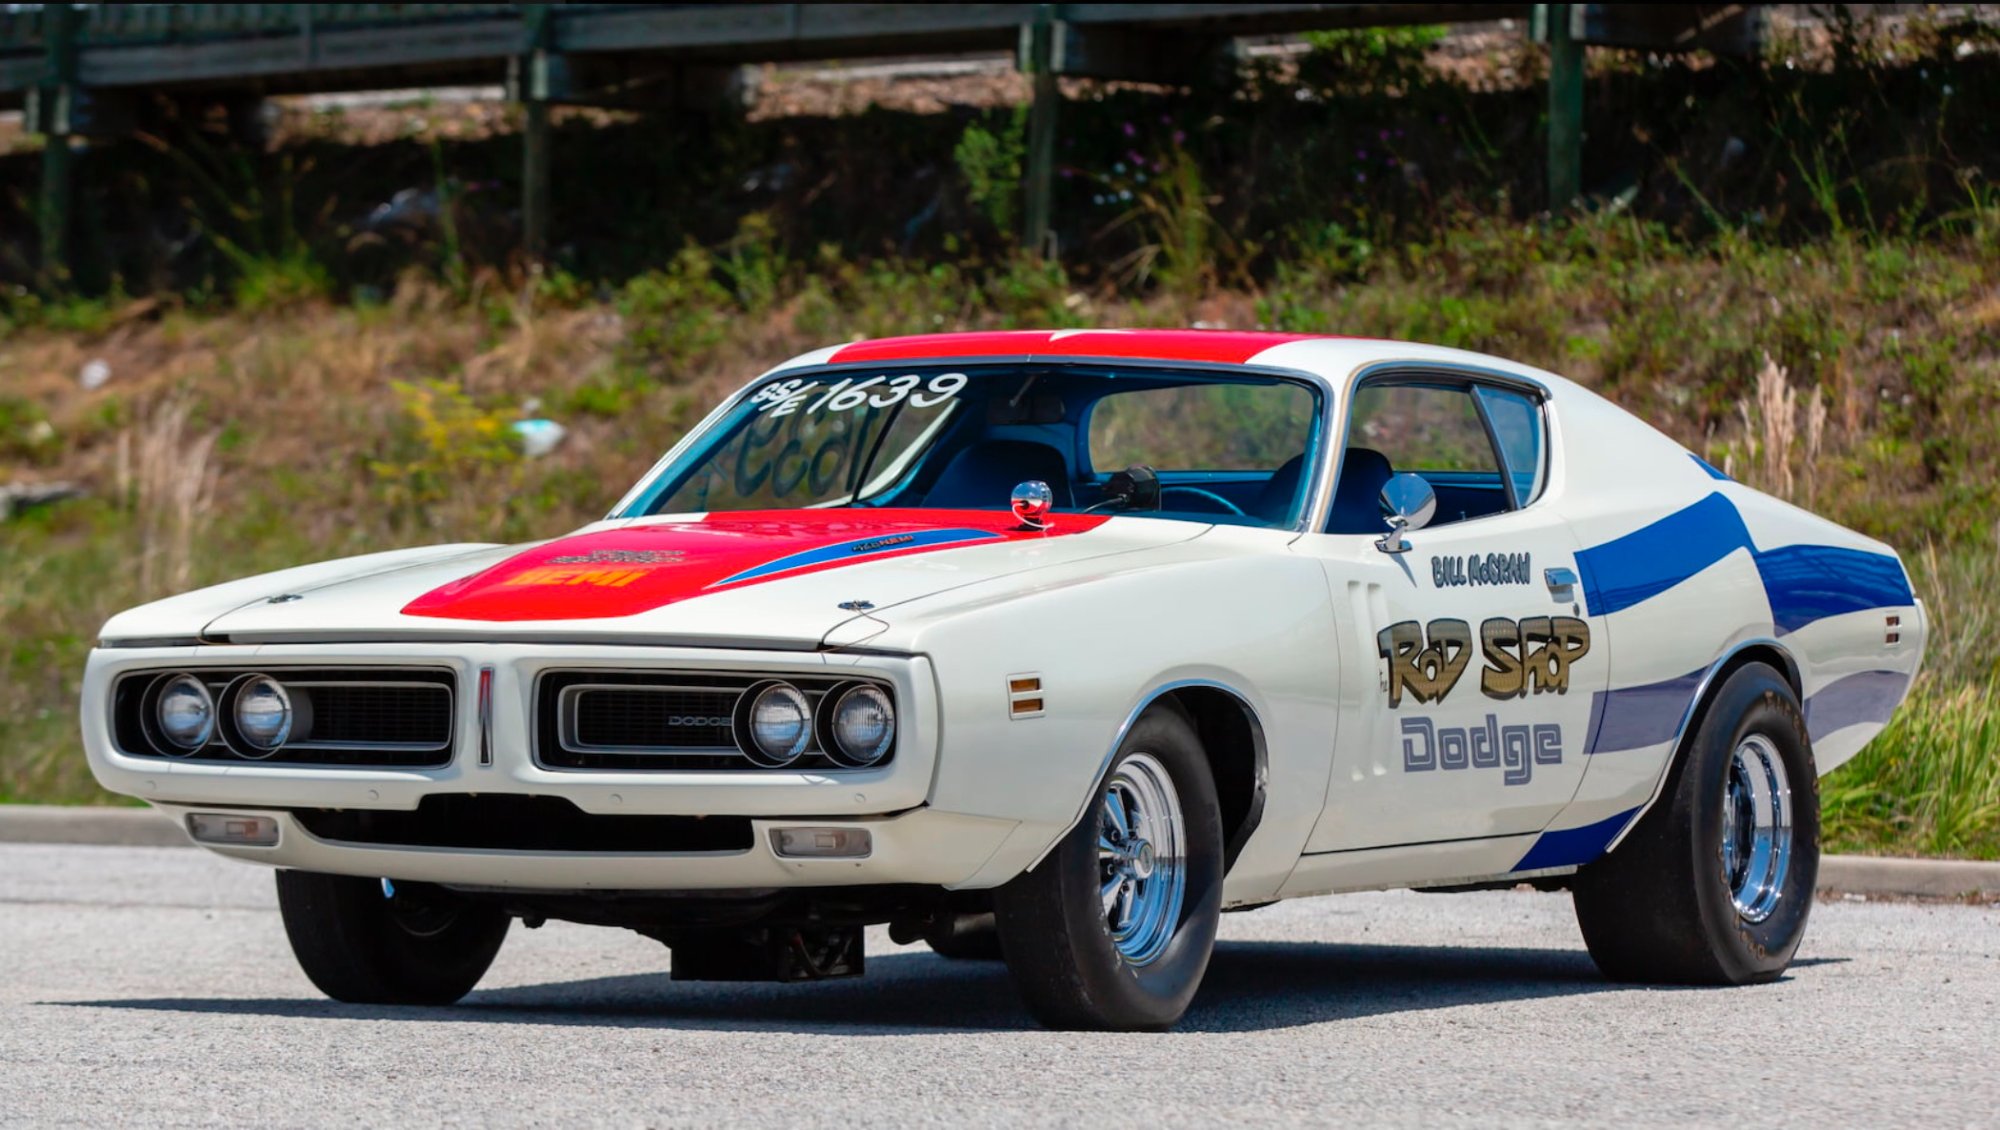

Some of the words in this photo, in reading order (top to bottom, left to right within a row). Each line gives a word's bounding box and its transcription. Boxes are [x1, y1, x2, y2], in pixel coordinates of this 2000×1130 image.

[807, 373, 968, 414] 1639
[503, 567, 650, 587] HEMI
[1431, 555, 1467, 588] BILL
[1401, 714, 1563, 786] Dodge
